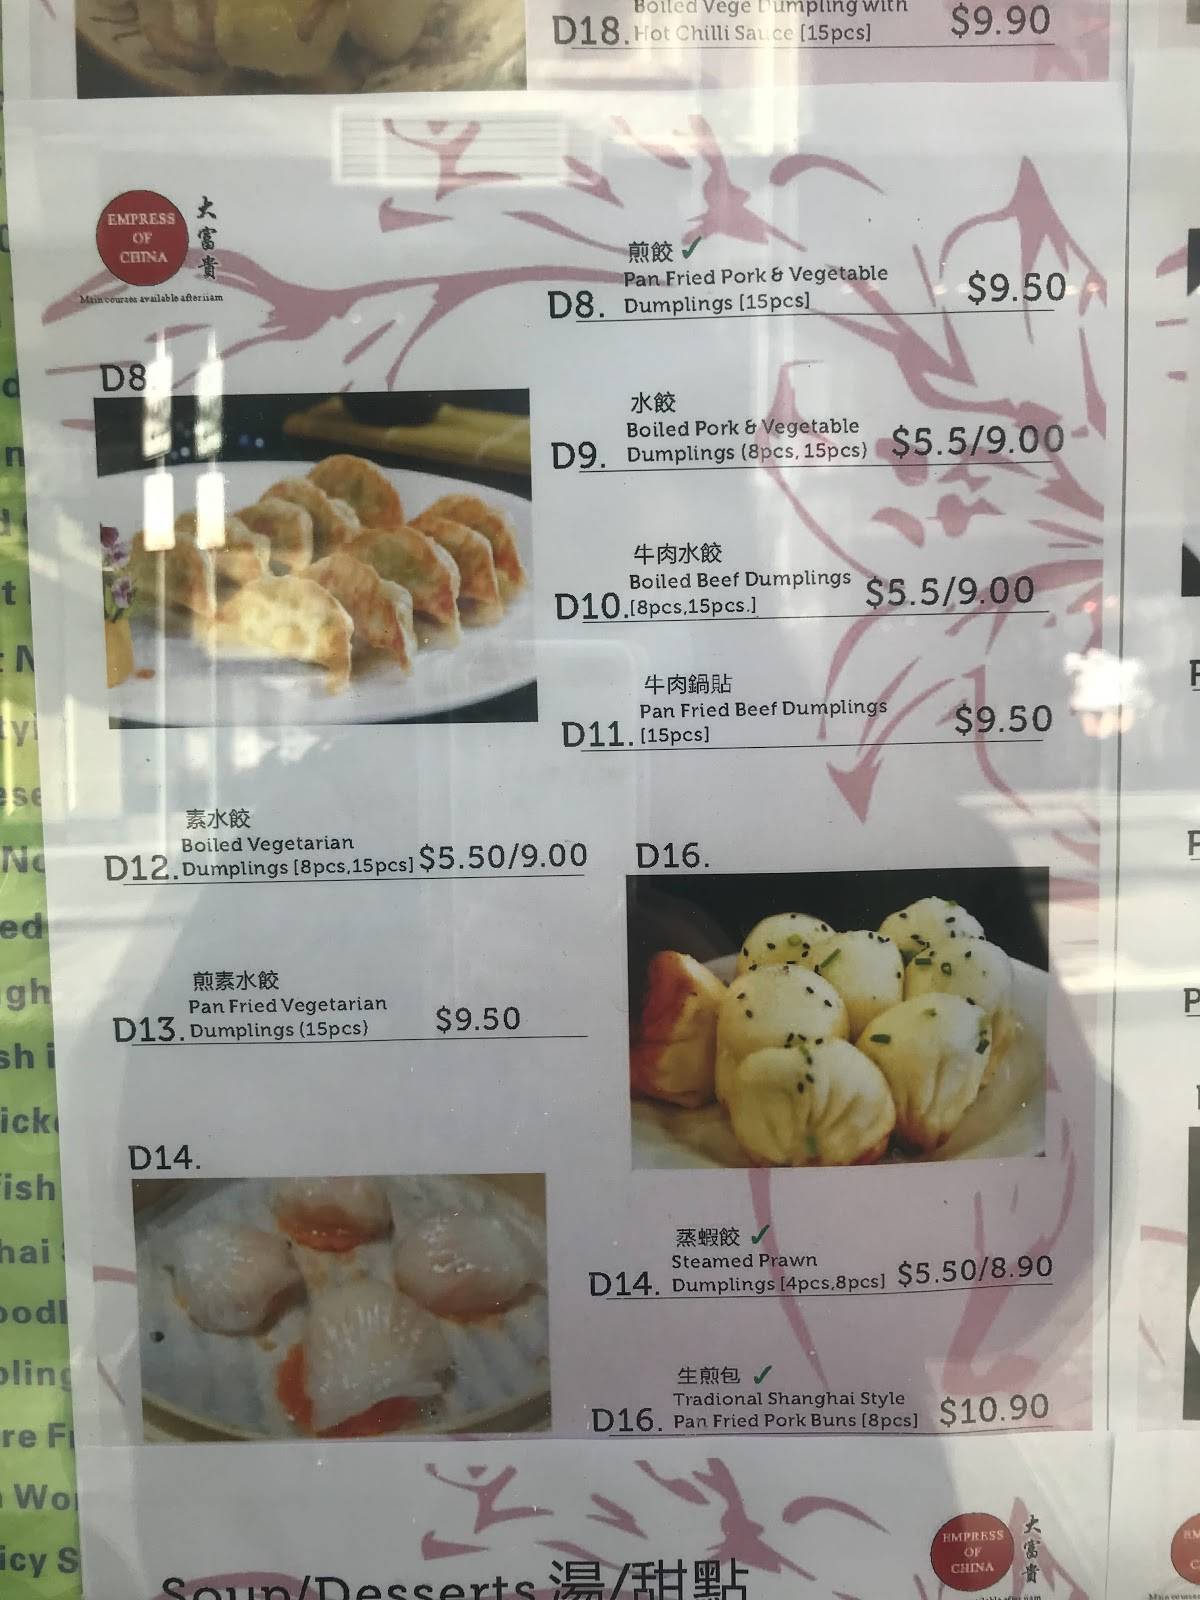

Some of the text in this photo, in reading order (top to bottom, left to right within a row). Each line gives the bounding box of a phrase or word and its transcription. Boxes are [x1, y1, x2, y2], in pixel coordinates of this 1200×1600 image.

[704, 0, 751, 17] Vege
[552, 16, 629, 45] D18.
[951, 2, 1050, 38] $9.90
[634, 24, 871, 45] Hot Chilli Sauce [15pcs]
[108, 213, 175, 226] EMPRESS
[132, 232, 152, 244] OF
[120, 252, 168, 264] CHINA
[629, 241, 673, 263] 煎餃
[624, 265, 888, 287] Pan Fried Pork & Vegetable
[140, 293, 178, 303] available
[968, 270, 1066, 305] $9.50
[548, 291, 604, 319] D8.
[625, 292, 810, 316] Dumplings [15pcs]
[631, 391, 676, 413] 水餃
[627, 417, 859, 438] Boiled Pork & Vegetable
[889, 424, 1064, 458] $5.5/9.00
[551, 441, 605, 469] D9.
[627, 446, 735, 463] Dumplings
[634, 542, 722, 565] 牛肉水餃
[629, 570, 851, 589] Boiled Beef Dumplings
[866, 576, 1034, 609] $5.5/9.00
[555, 592, 628, 619] D10.
[644, 674, 732, 695] 牛肉鍋貼
[640, 700, 887, 718] Pan Fried Beef Dumplings
[955, 704, 1051, 736] $9.50
[562, 721, 633, 747] D11.
[641, 727, 709, 744] [15pcs]
[186, 809, 251, 829] 素水餃
[182, 836, 354, 853] Boiled Vegetarian
[419, 843, 588, 872] $5.50/9.00
[636, 842, 710, 869] D16.
[104, 854, 178, 881] D12.
[183, 857, 414, 879] Dumplings [8pcs,15pcs]
[193, 971, 279, 991] 煎素水餃
[189, 997, 387, 1015] Pan Fried Vegetarian
[113, 1016, 185, 1042] D13.
[191, 1019, 368, 1040] Dumplings (15pcs)
[436, 1006, 520, 1033] $9.50
[128, 1145, 201, 1170] D14.
[676, 1228, 740, 1247] 蒸蝦餃
[672, 1253, 817, 1268] Steamed Prawn
[898, 1256, 1052, 1287] $5.50/8.90
[589, 1271, 660, 1296] D14.
[672, 1274, 885, 1294] Dumplings [4pcs,8pcs]
[678, 1366, 740, 1385] 生煎包
[673, 1392, 905, 1408] Tradional Shanghai Style
[940, 1394, 1049, 1427] $10.90
[592, 1408, 663, 1432] D16.
[674, 1413, 918, 1430] Pan Fried Pork Buns [8pcs]
[943, 1530, 1004, 1542] EMPRESS
[964, 1547, 982, 1557] OF
[951, 1562, 994, 1574] CHINA
